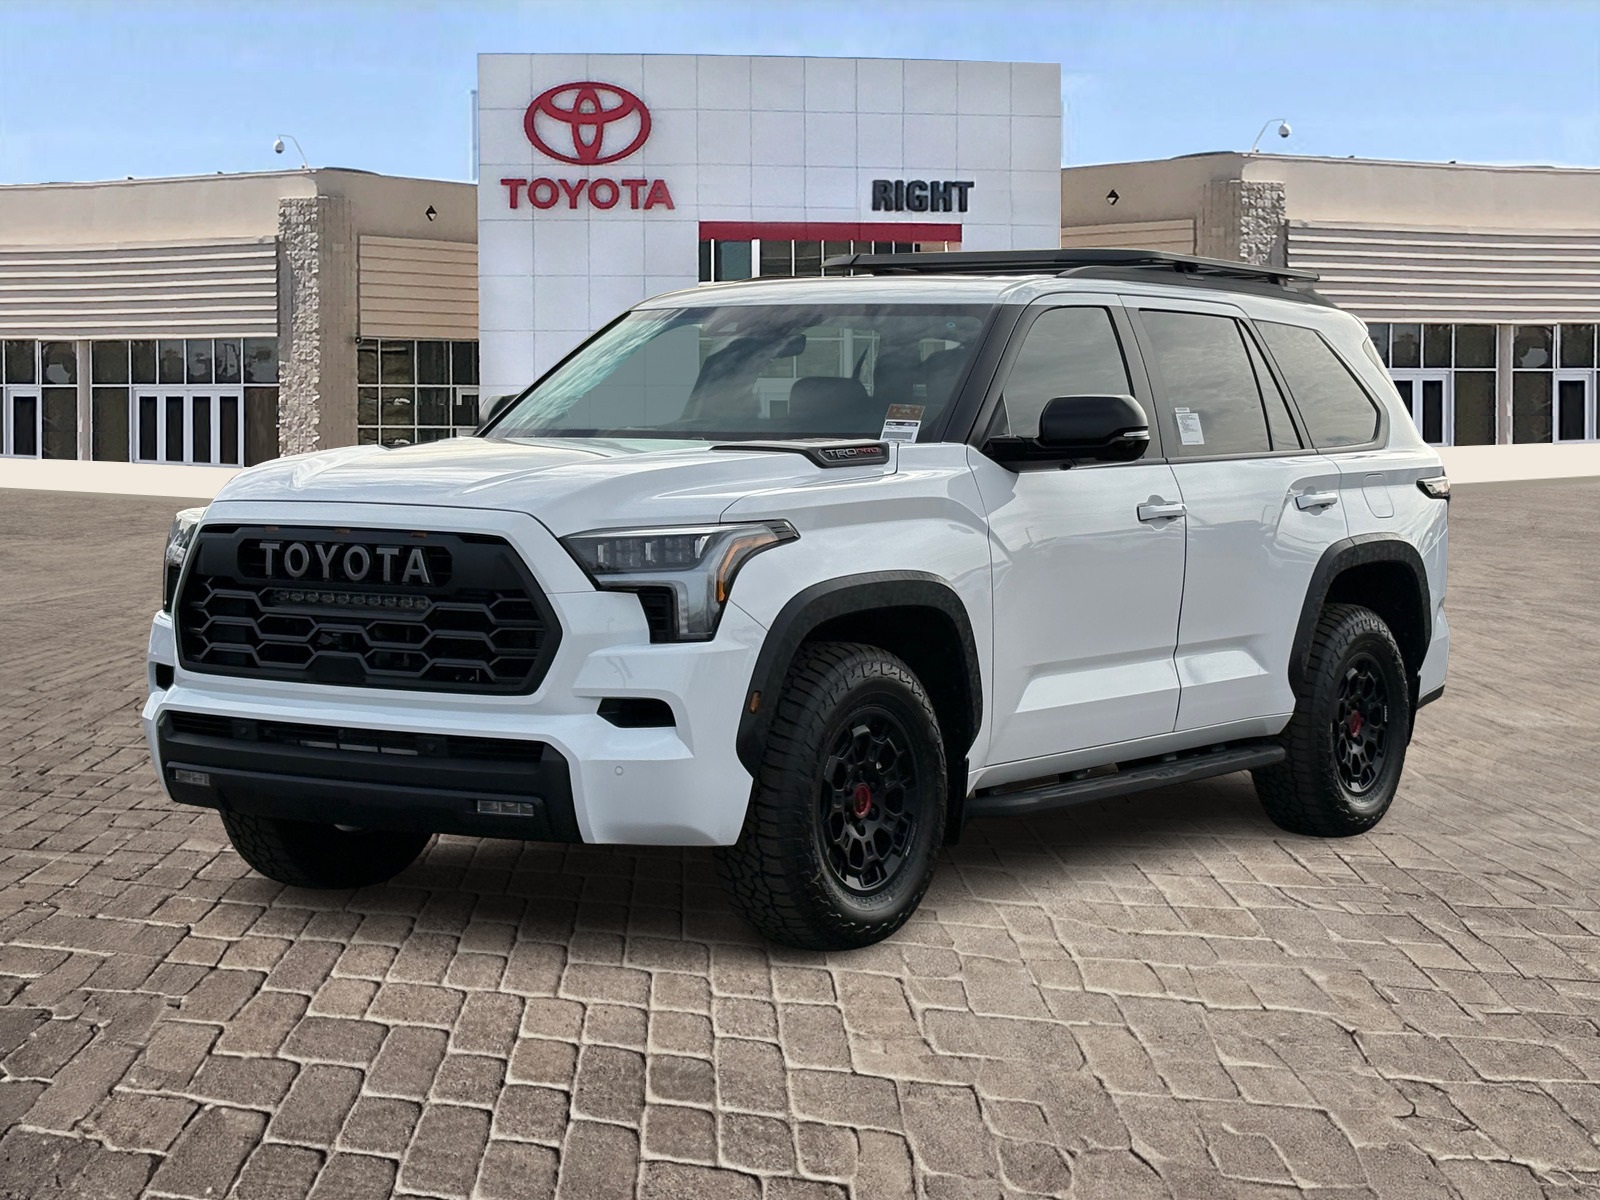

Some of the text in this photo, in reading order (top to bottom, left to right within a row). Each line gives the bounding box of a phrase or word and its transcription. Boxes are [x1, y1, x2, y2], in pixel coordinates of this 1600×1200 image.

[500, 178, 675, 209] TOYOTA
[872, 180, 974, 212] RIGHT
[259, 542, 430, 584] TOYOTA
